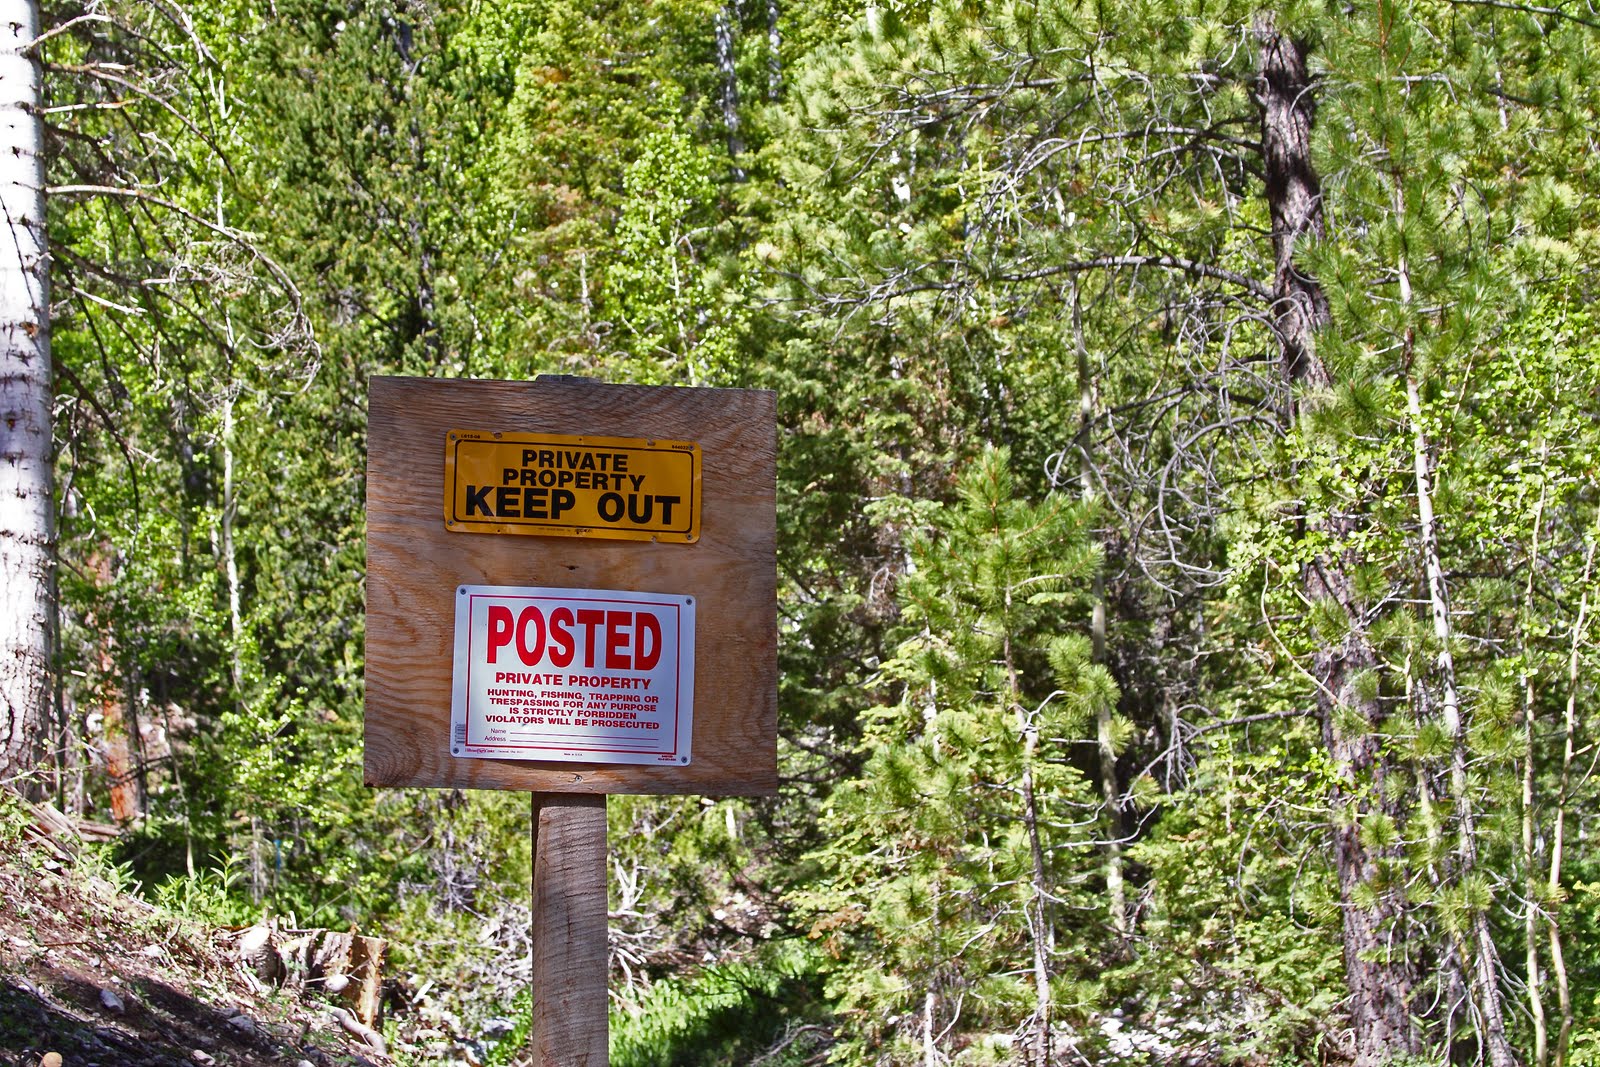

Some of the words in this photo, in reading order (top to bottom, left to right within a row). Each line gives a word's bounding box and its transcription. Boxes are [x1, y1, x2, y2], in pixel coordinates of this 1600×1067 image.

[522, 449, 628, 472] PRIVATE
[502, 468, 646, 491] PROPERTY
[465, 485, 575, 519] KEEP
[597, 492, 681, 525] OUT
[486, 604, 662, 671] POSTED
[495, 672, 563, 686] PRIVATE
[568, 675, 651, 689] PROPERTY
[487, 689, 538, 699] HUNTING,
[541, 691, 586, 701] FISHING,
[589, 693, 641, 703] TRAPPING
[644, 695, 659, 704] OR
[489, 697, 560, 707] TRESPASSING
[563, 700, 584, 709] FOR
[586, 701, 607, 710] ANY
[611, 702, 657, 712] PURPOSE
[509, 707, 519, 715] IS
[523, 707, 574, 717] STRICTLY
[577, 710, 637, 720] FORBIDDEN
[485, 715, 544, 724] VIOLATORS
[548, 718, 571, 726] WILL
[574, 718, 588, 726] BE
[591, 720, 660, 730] PROSECUTED
